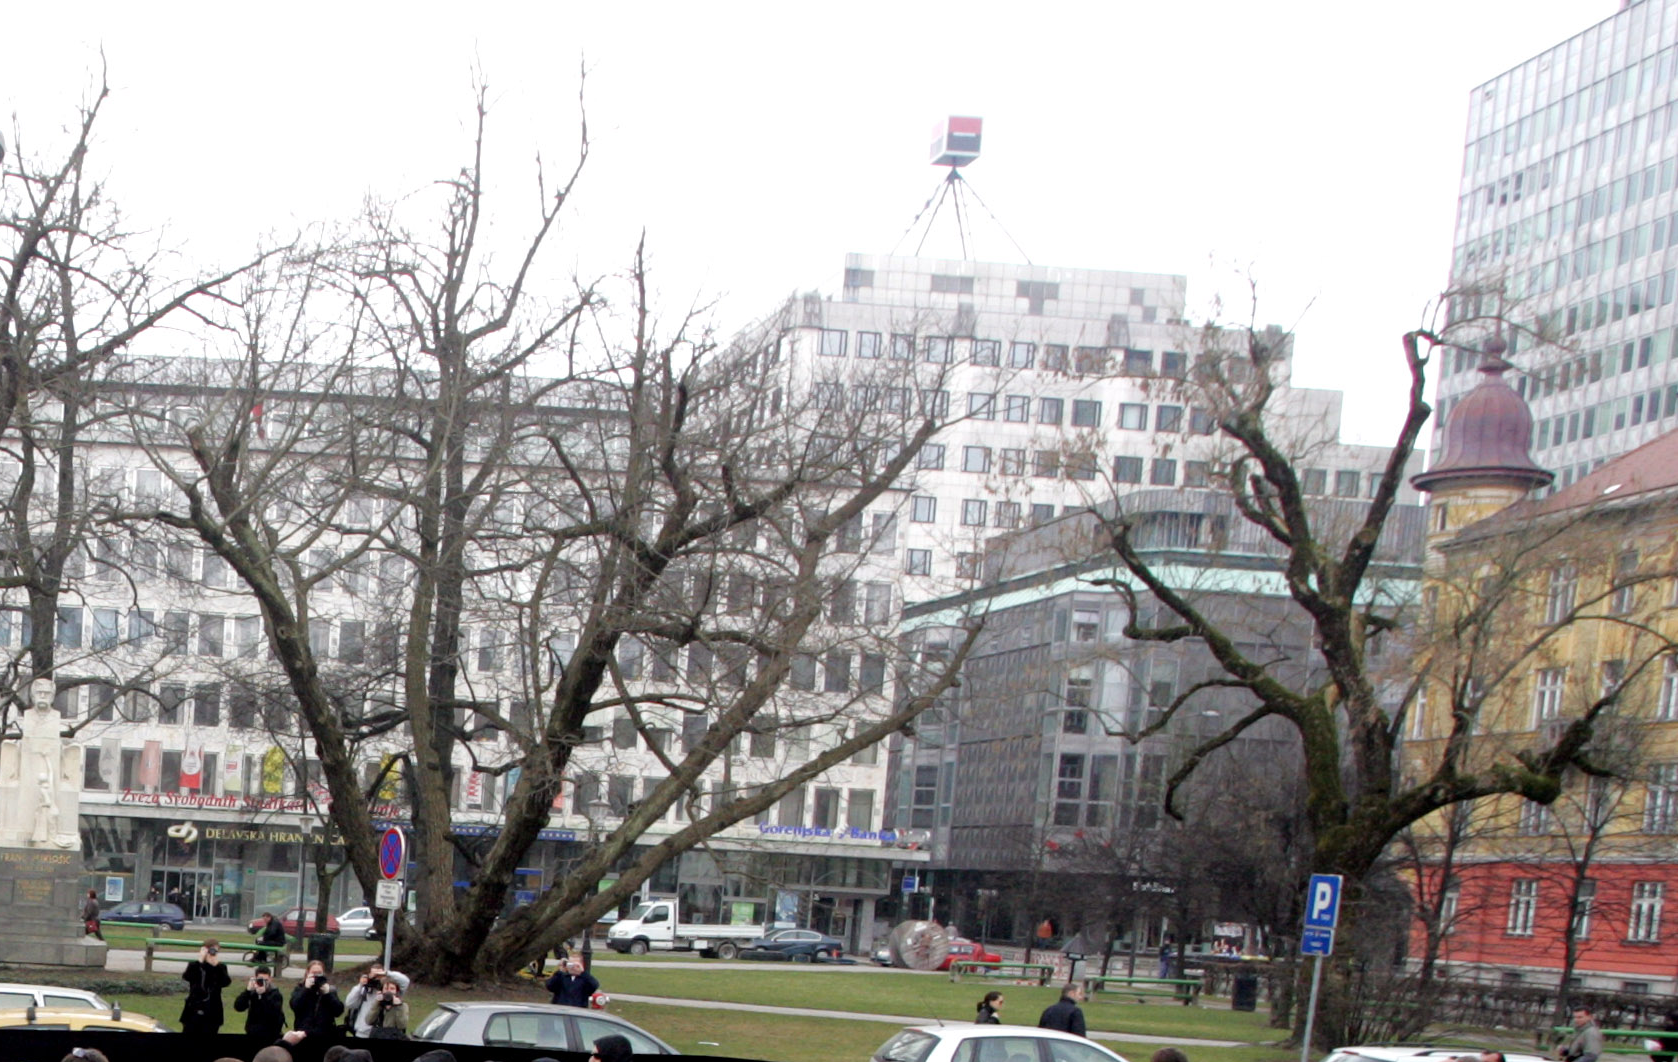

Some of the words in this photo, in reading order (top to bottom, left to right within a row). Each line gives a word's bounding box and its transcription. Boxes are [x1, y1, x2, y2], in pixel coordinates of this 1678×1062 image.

[121, 787, 161, 804] Zveza
[164, 791, 237, 808] Svobodnih
[205, 828, 265, 842] DELAVSKA
[758, 822, 831, 838] Gorenjska
[850, 826, 897, 841] Banka
[1311, 882, 1332, 919] P
